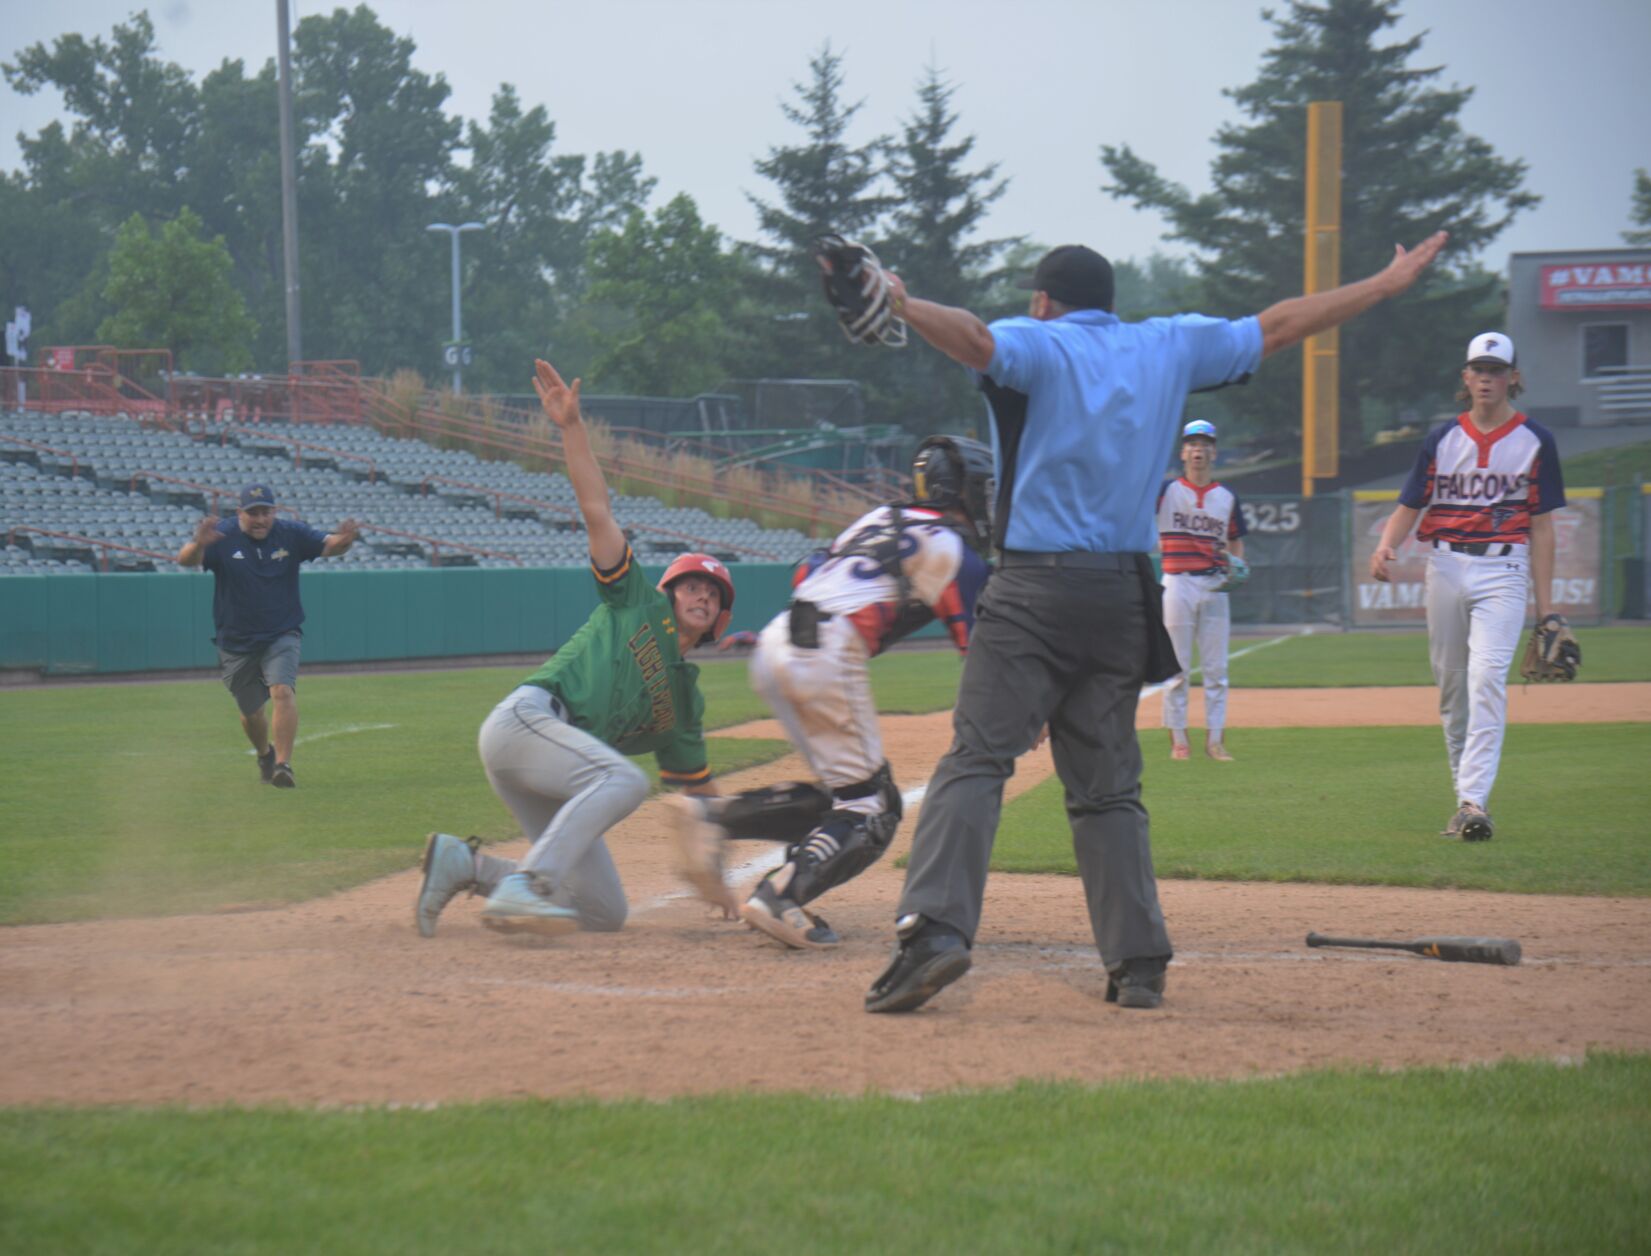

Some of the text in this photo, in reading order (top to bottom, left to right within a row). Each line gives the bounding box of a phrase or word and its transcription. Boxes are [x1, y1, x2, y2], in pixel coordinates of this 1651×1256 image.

[1550, 265, 1651, 287] #VAM
[1437, 474, 1527, 500] FALCONS
[1241, 502, 1300, 531] 325
[1358, 583, 1425, 609] VAM
